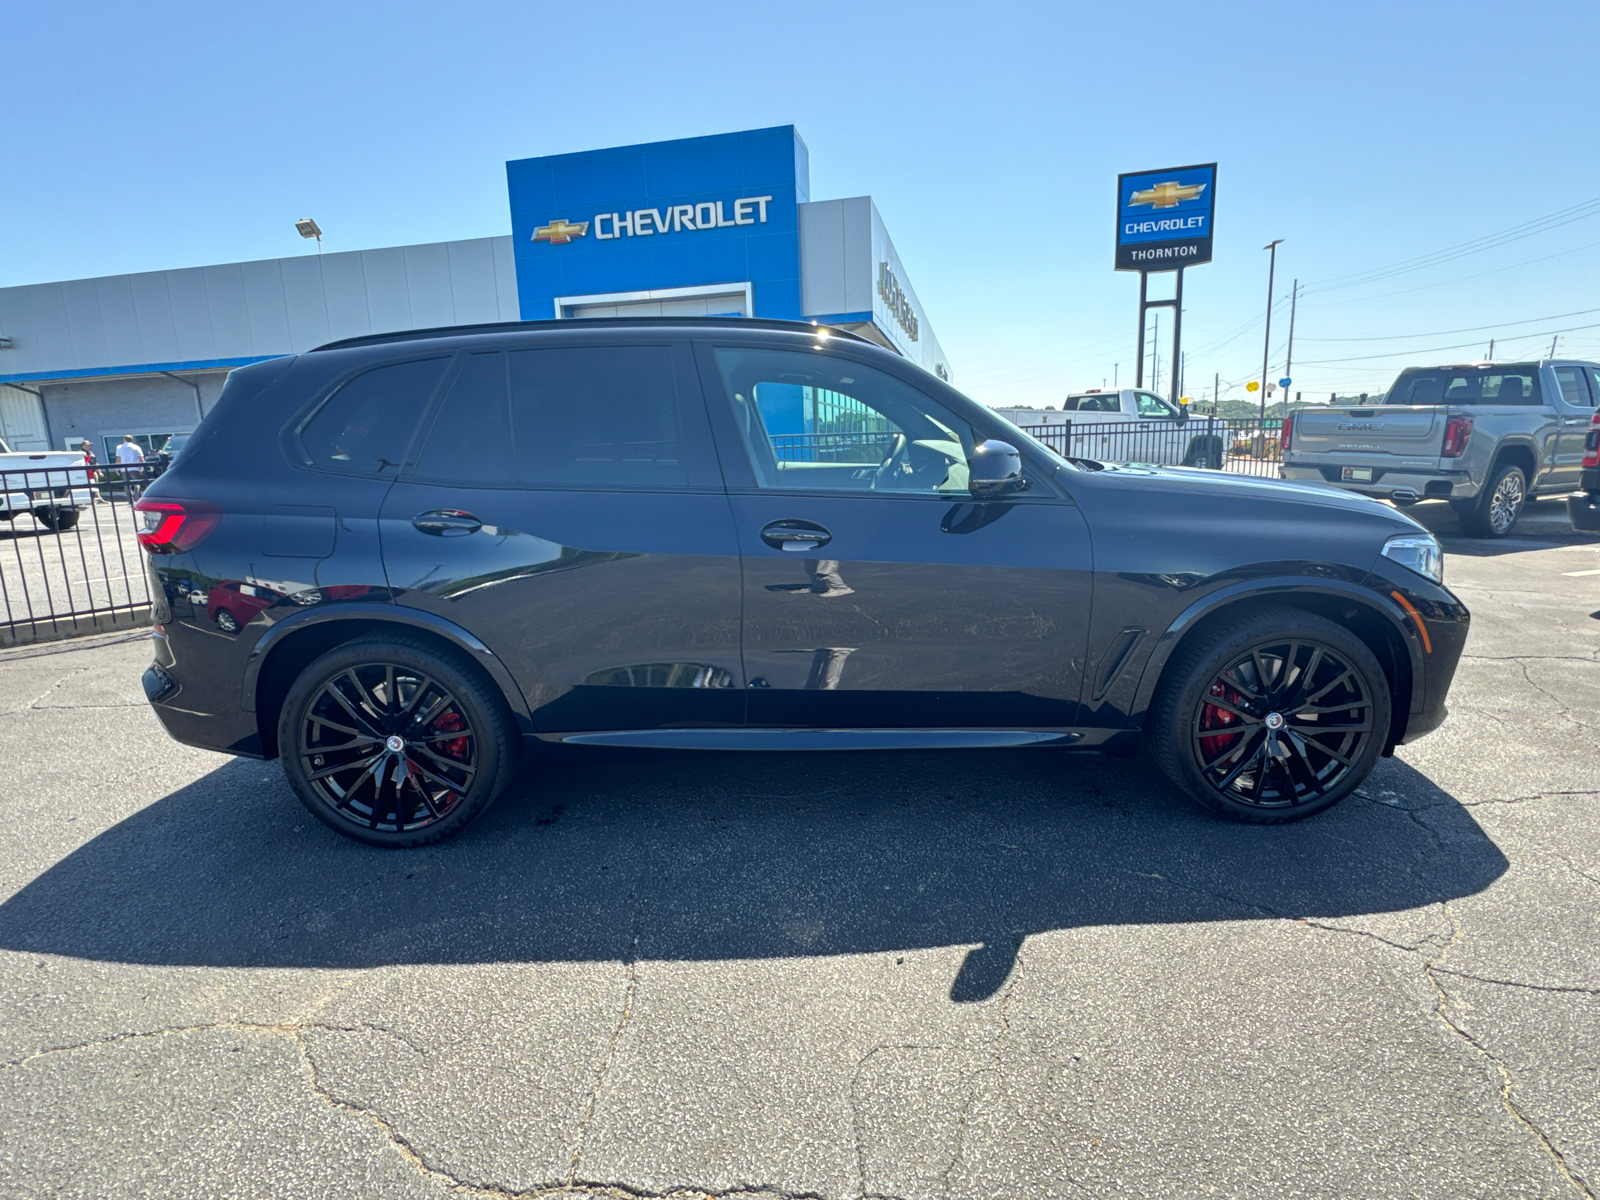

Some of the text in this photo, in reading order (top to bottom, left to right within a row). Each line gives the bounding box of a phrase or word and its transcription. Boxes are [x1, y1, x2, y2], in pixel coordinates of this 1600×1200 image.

[594, 195, 772, 240] CHEVROLET
[1125, 216, 1205, 235] CHEVROLET
[1131, 245, 1197, 260] THORNTON
[1338, 422, 1384, 431] GMC
